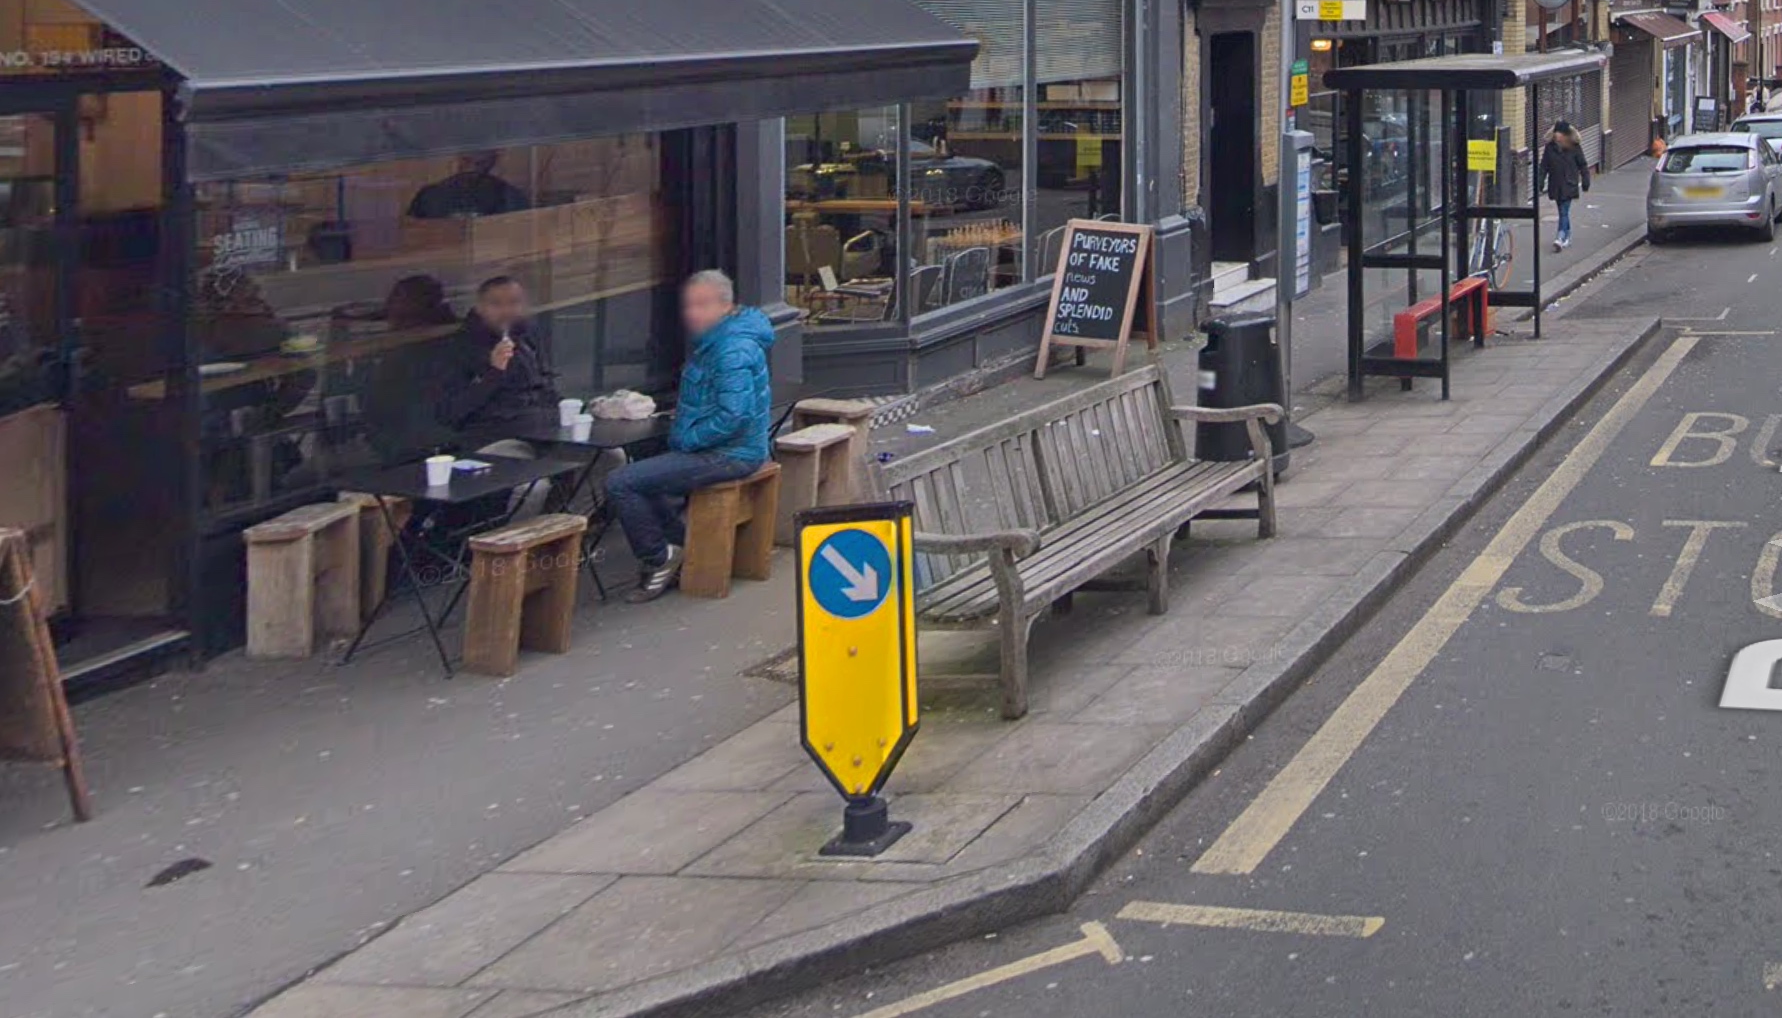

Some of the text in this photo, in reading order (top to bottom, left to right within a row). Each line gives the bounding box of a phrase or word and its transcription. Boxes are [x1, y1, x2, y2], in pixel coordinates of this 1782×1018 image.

[1301, 5, 1314, 14] C11
[81, 47, 140, 66] WIRED
[1073, 233, 1137, 254] PURVEYORS
[1069, 253, 1120, 272] OF FAKE
[1066, 273, 1096, 285] news
[1061, 287, 1088, 302] AND
[1057, 303, 1113, 320] SPLENDID
